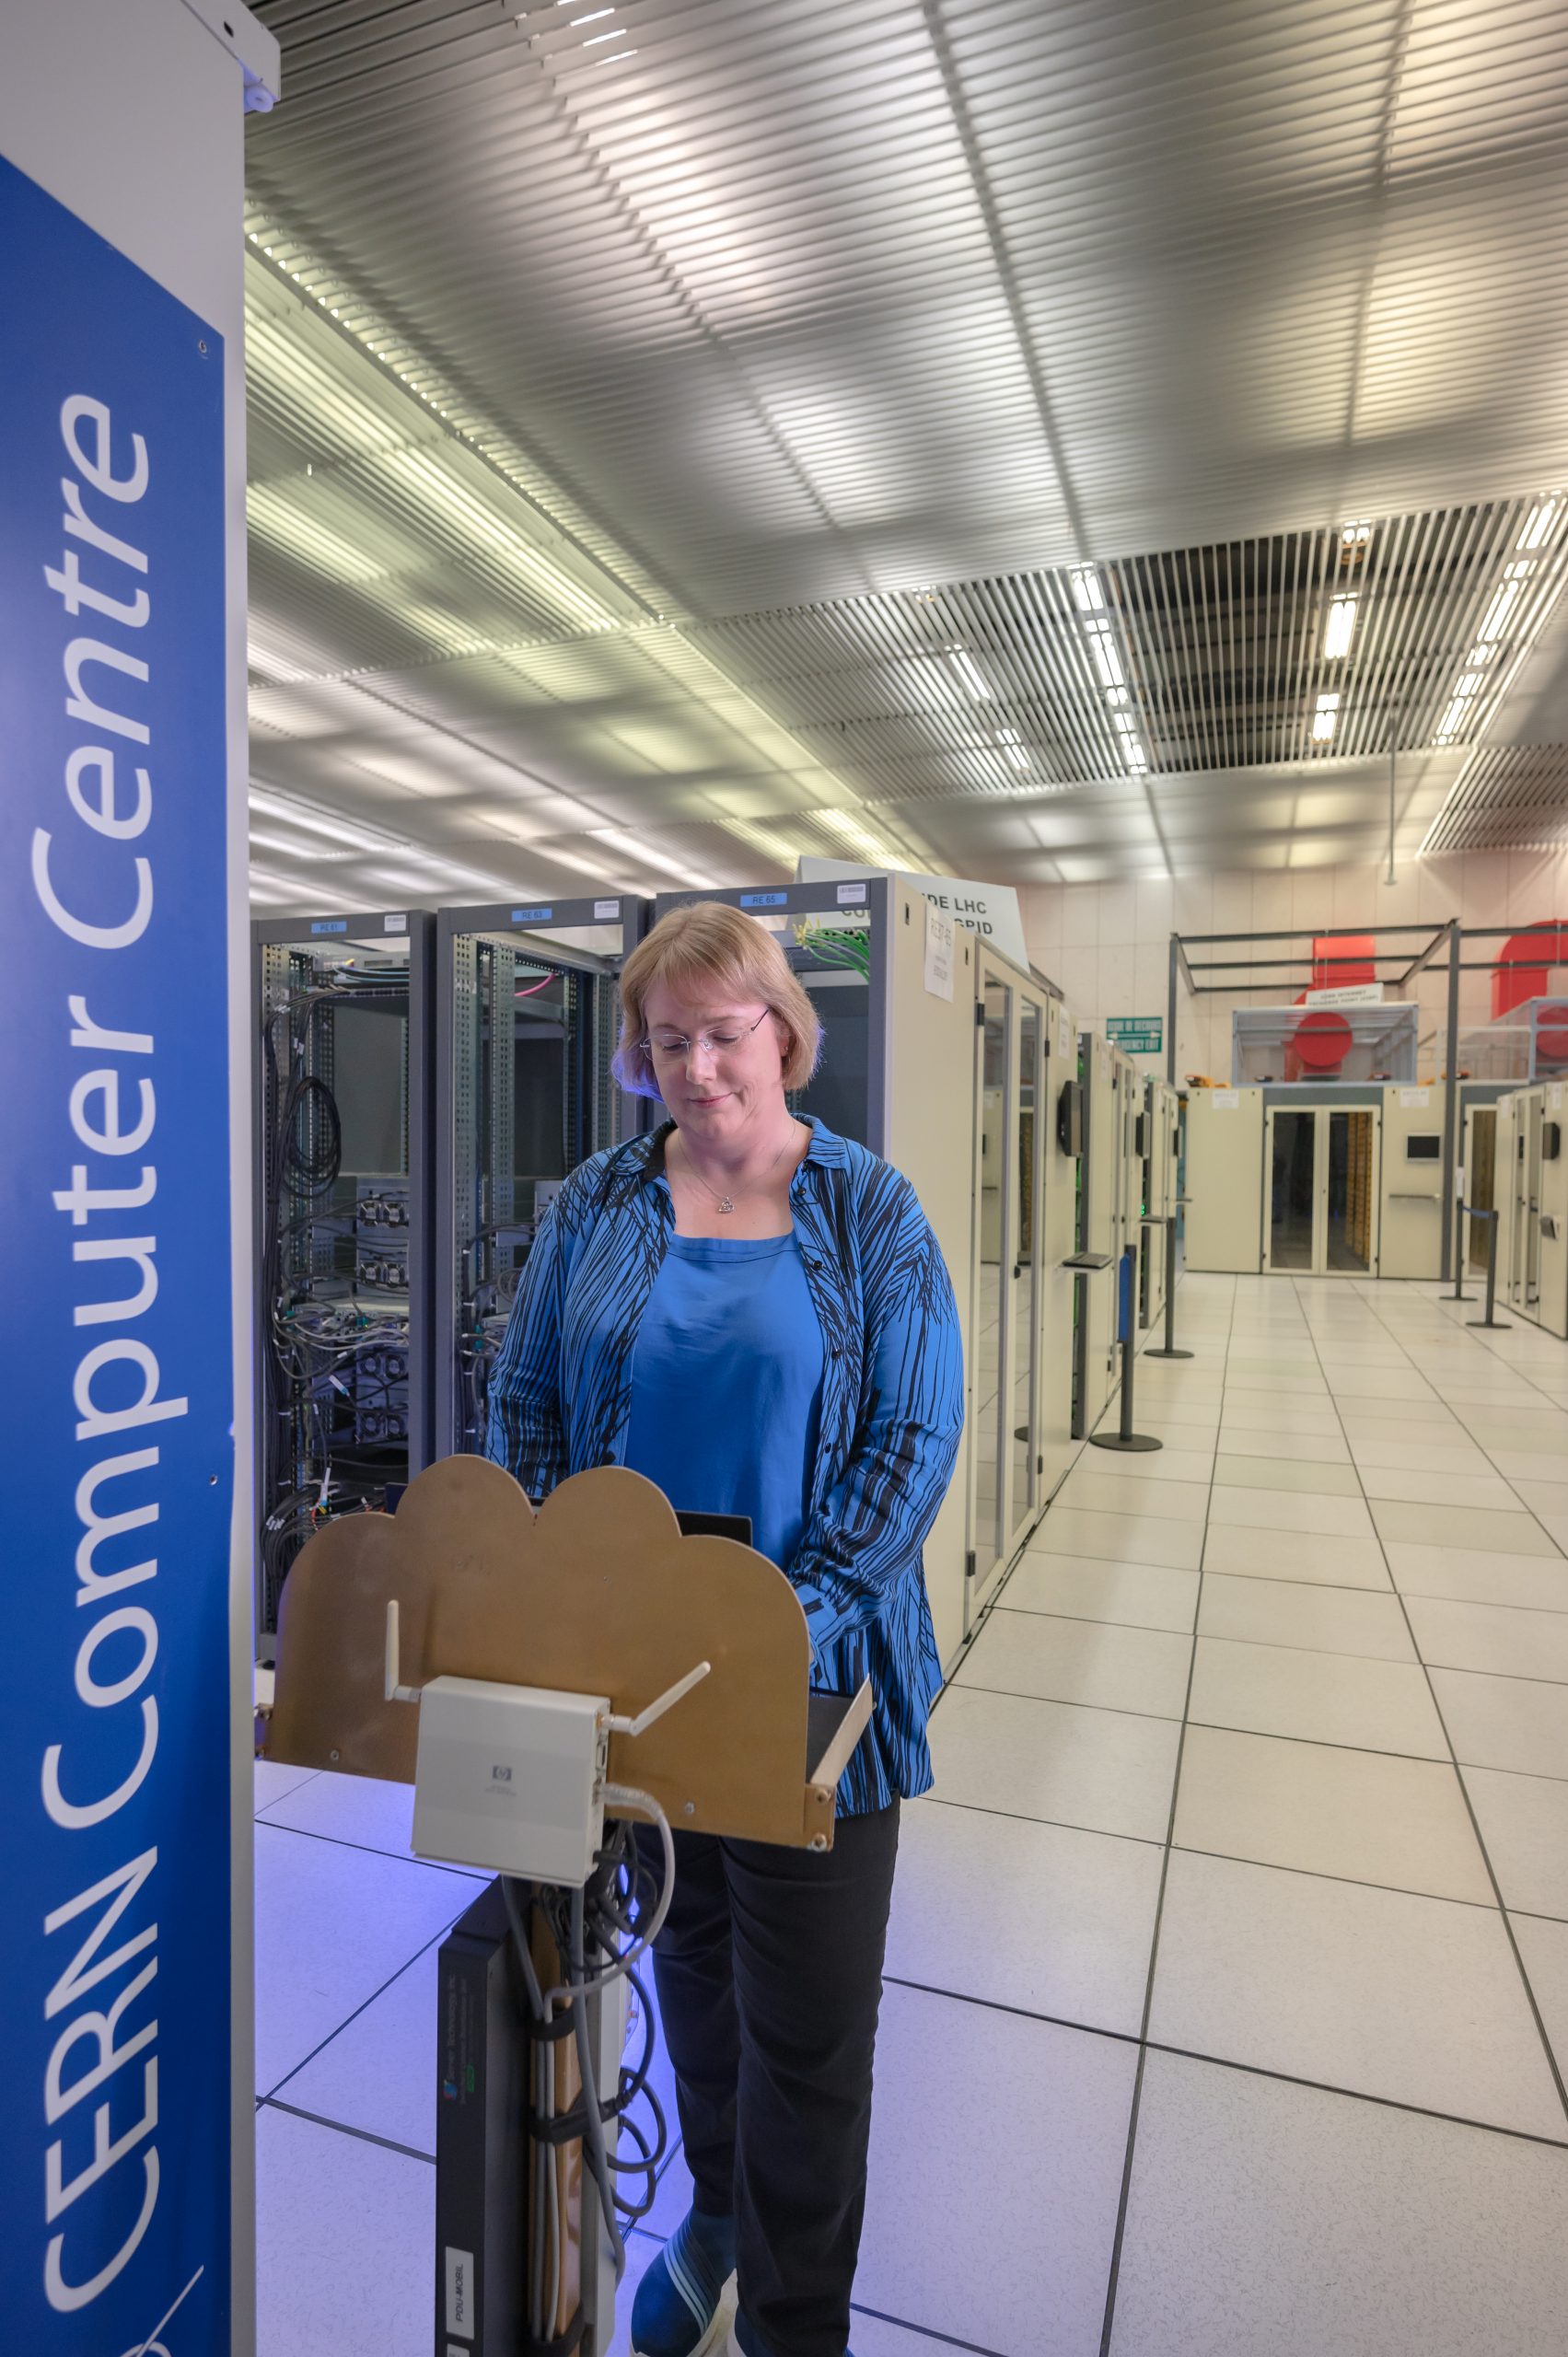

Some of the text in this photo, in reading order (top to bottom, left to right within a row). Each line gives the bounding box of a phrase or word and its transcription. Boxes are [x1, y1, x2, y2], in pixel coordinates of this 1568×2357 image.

[31, 394, 189, 2313] CERN Computer Centre
[954, 898, 987, 914] LHC
